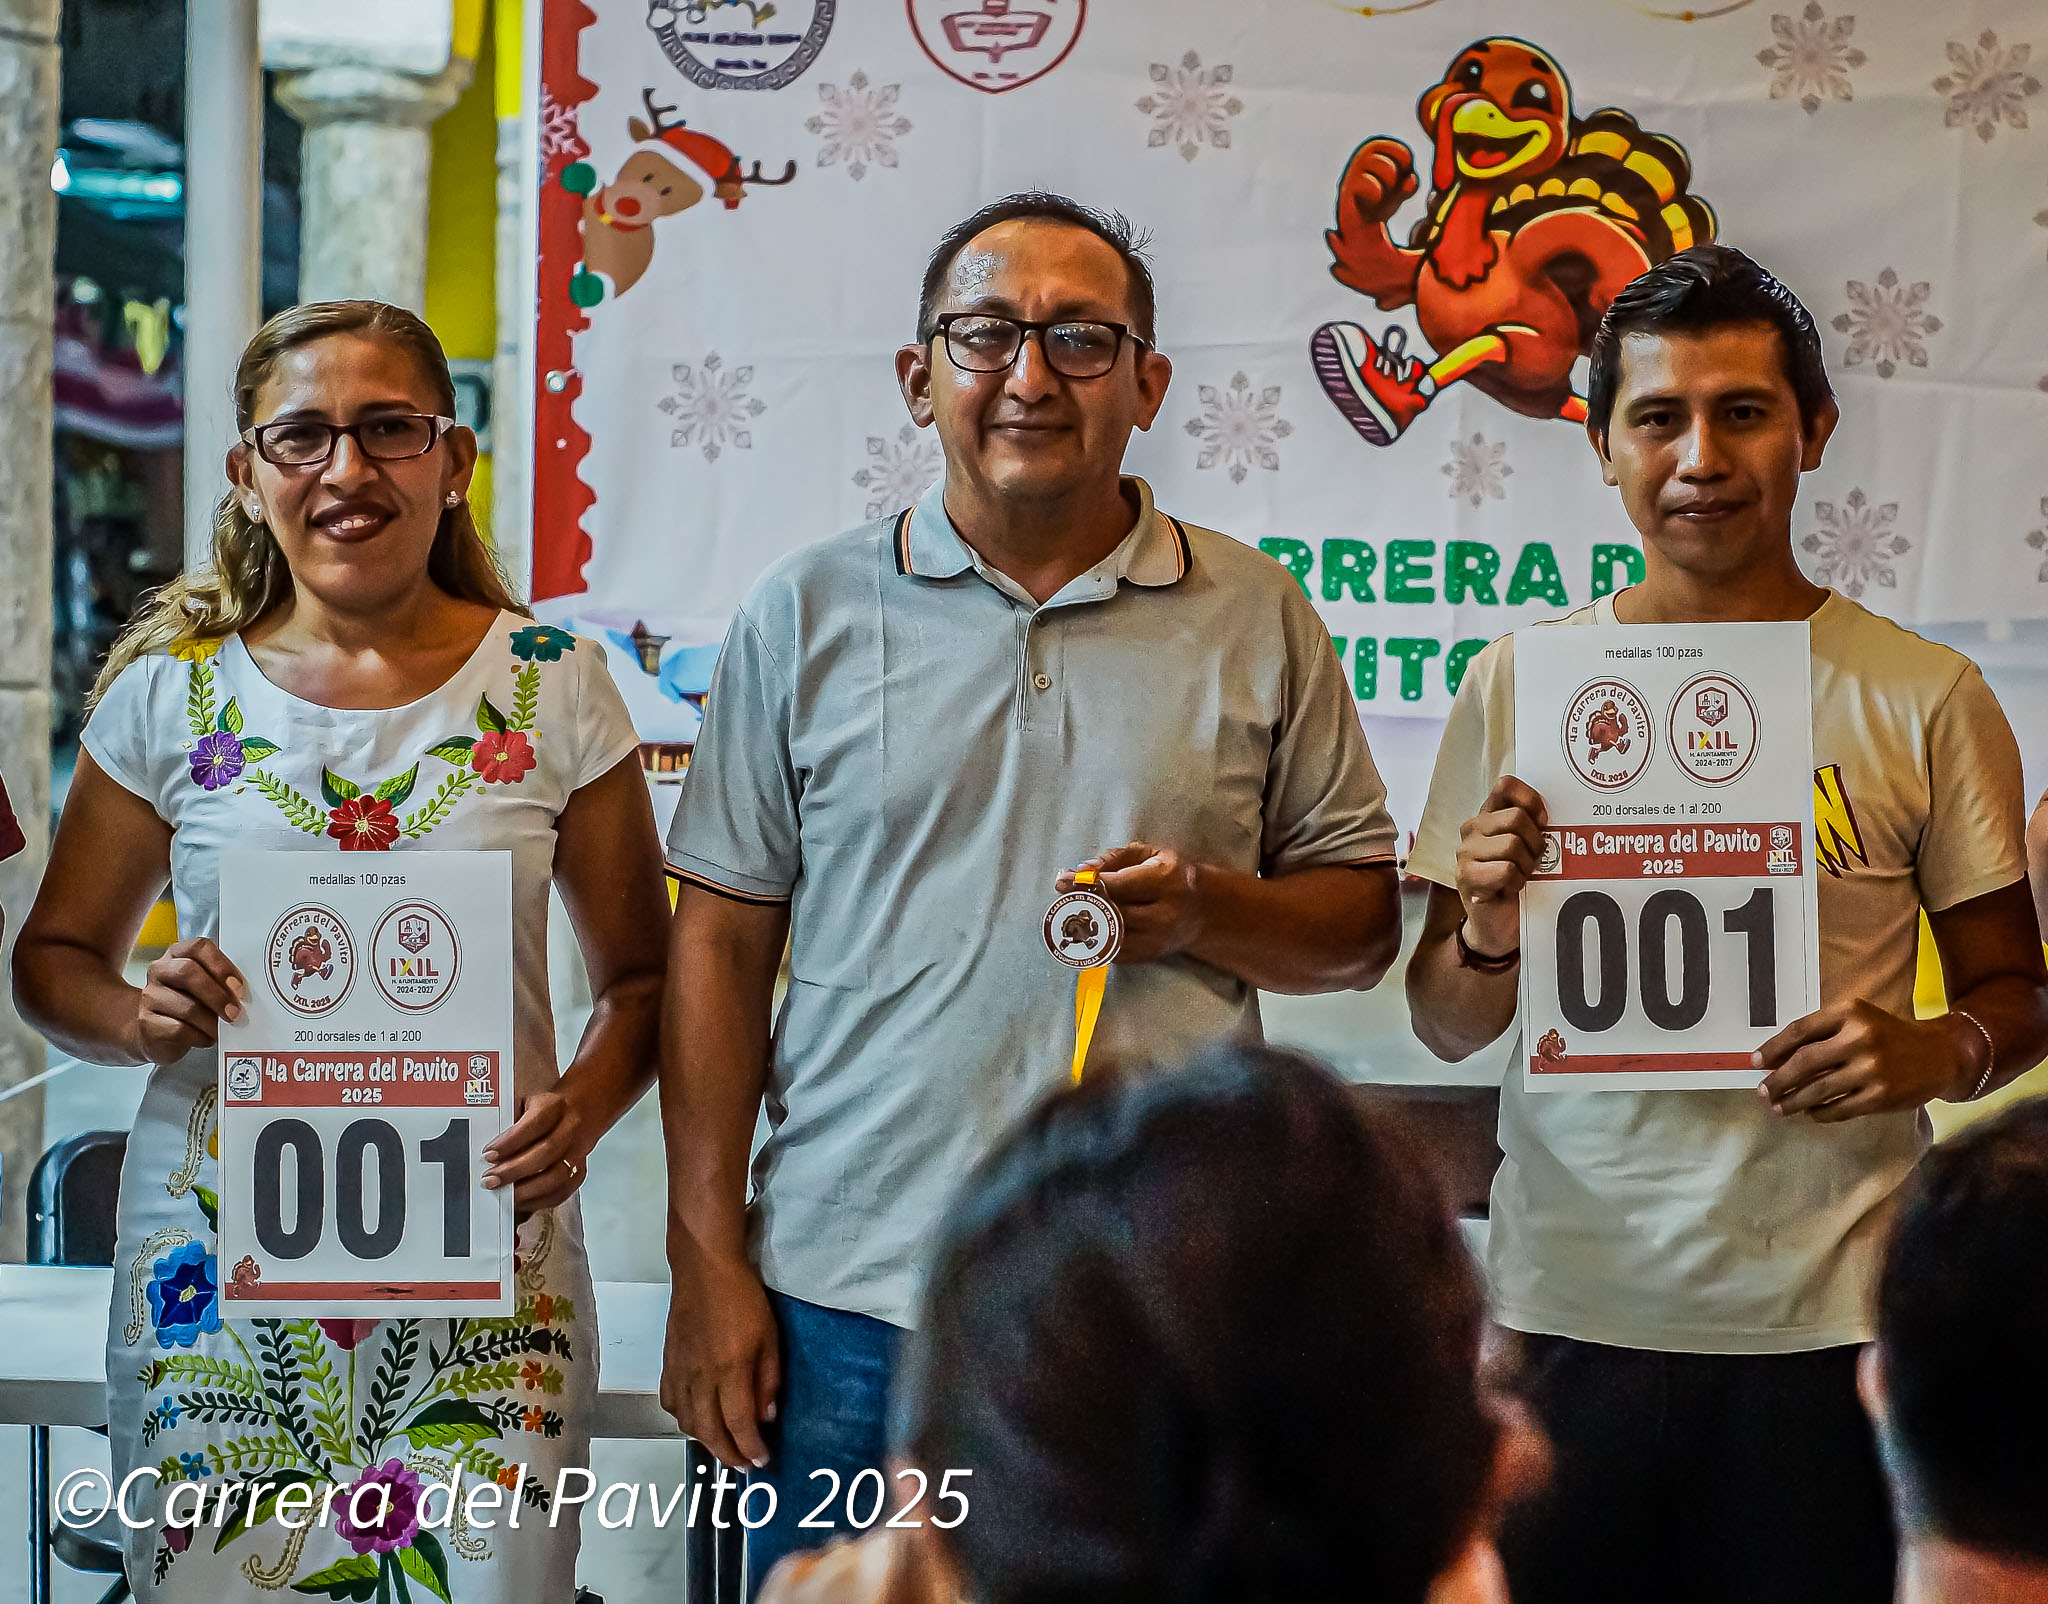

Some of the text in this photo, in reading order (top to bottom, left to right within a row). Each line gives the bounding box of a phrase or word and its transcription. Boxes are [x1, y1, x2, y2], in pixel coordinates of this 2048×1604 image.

[1605, 646, 1704, 660] medallas 100 pzas
[1572, 688, 1606, 722] Carrera
[1609, 687, 1627, 702] del
[1688, 731, 1738, 749] IXIL
[1592, 802, 1722, 816] 200 dorsales de 1 al 200
[1564, 827, 1761, 856] 4a Carrera del Pavito
[1642, 859, 1684, 874] 2025
[309, 873, 406, 887] medallas 100 pzas
[276, 914, 310, 948] Carrera
[313, 914, 330, 928] del
[390, 957, 439, 976] IXIL
[1556, 888, 1777, 1032] 001
[396, 986, 434, 994] 2024-2027
[294, 1030, 422, 1042] 200 dorsales de 1 al 200
[265, 1056, 459, 1083] 4a Carrera del Pavito
[341, 1088, 383, 1103] 2025
[253, 1118, 471, 1260] 001
